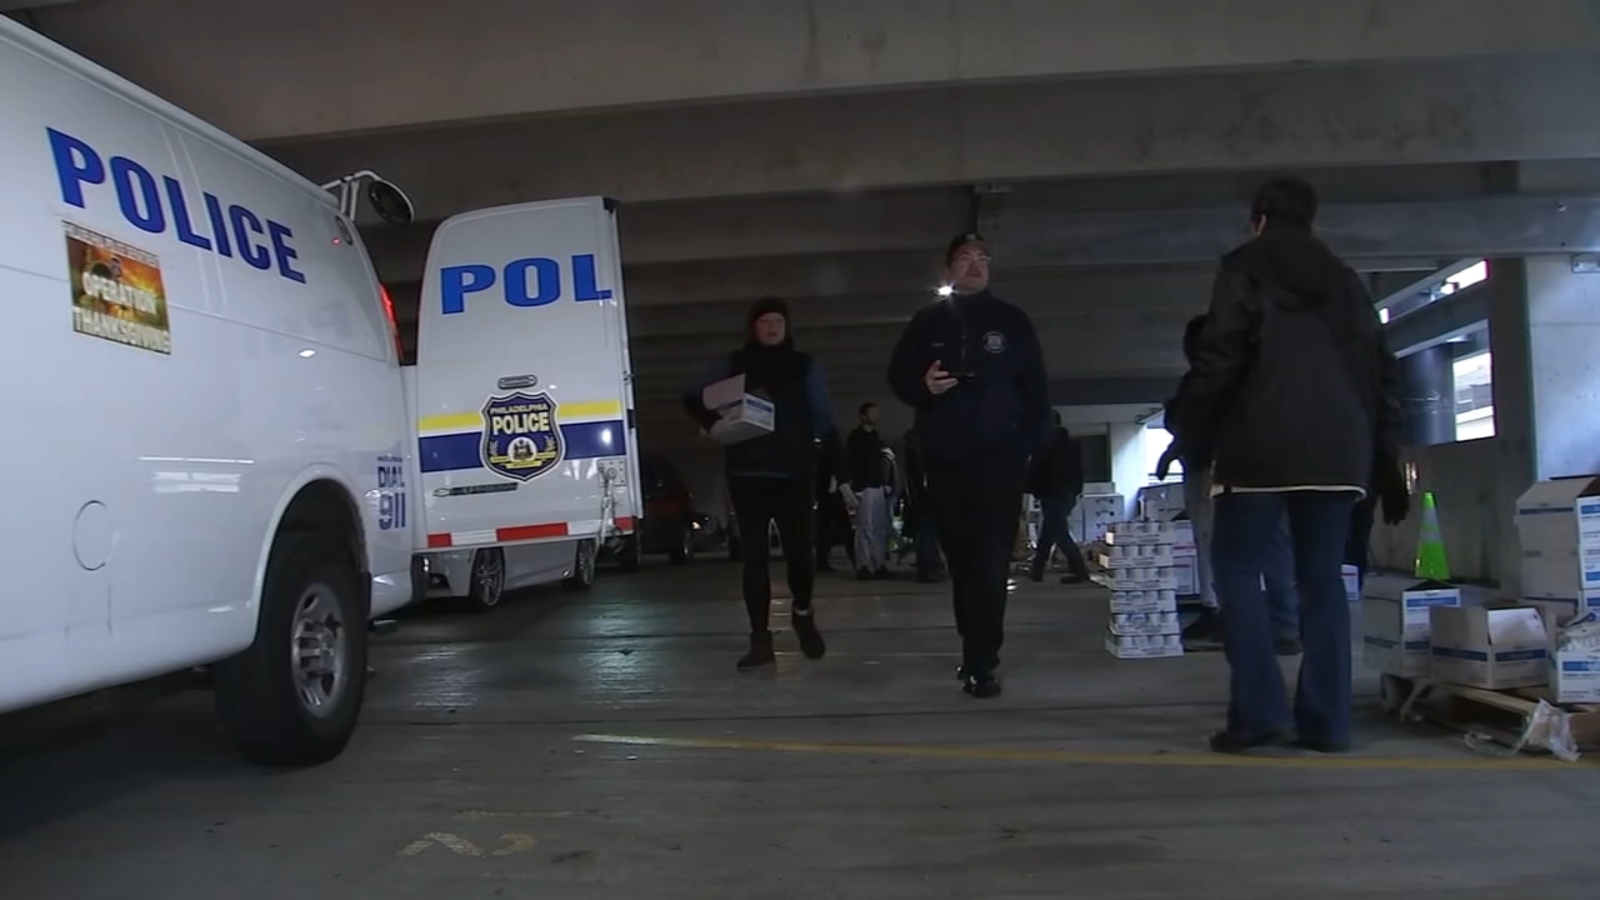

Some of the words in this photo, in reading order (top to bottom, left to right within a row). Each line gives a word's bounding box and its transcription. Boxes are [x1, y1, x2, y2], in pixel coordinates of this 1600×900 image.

[46, 127, 306, 284] POLICE
[440, 253, 611, 315] POL
[73, 306, 170, 353] THANKSGIVING
[492, 411, 550, 435] POLICE
[377, 466, 405, 488] DIAL
[379, 492, 405, 530] 911
